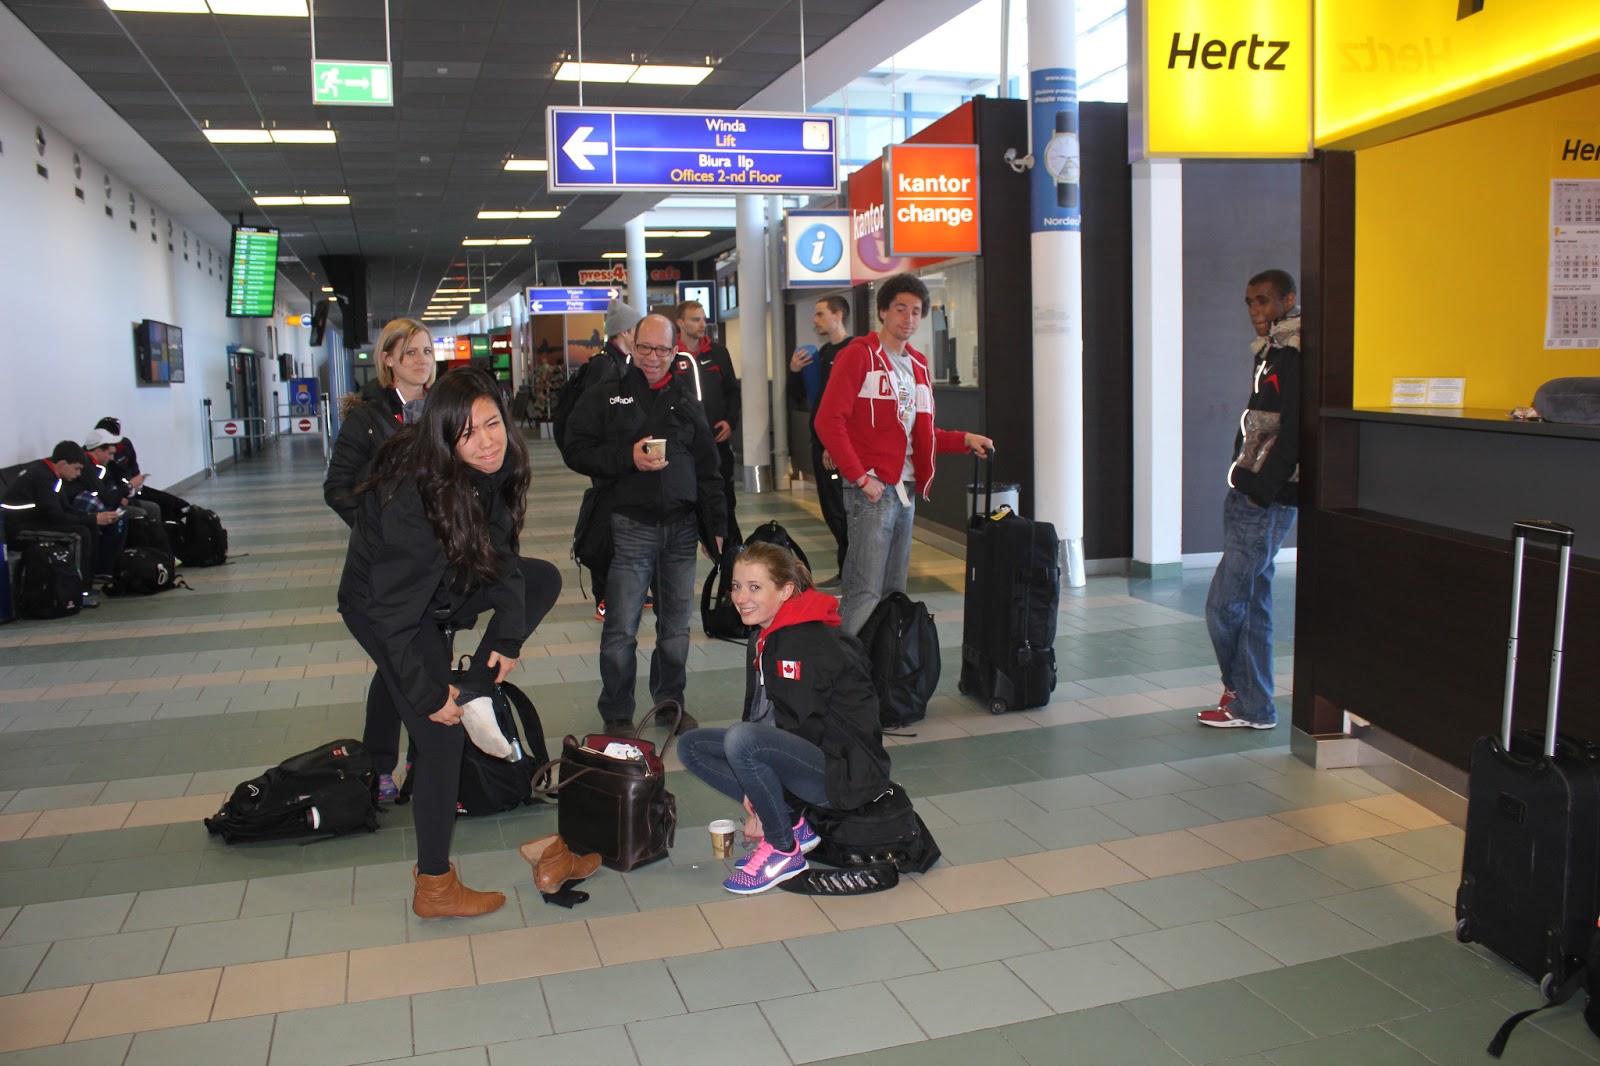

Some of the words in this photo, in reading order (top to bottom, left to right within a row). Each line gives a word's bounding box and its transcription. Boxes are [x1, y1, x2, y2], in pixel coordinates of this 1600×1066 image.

[1167, 32, 1291, 71] Hertz
[705, 118, 746, 133] Winda
[715, 134, 736, 148] Lift
[698, 154, 732, 168] Biura
[670, 169, 714, 183] Offices
[718, 170, 746, 184] 2-nd
[749, 170, 782, 184] Floor
[898, 174, 971, 193] kantor
[853, 202, 884, 240] kantor
[897, 204, 973, 226] change
[578, 264, 629, 286] press4y
[651, 266, 681, 280] cafe
